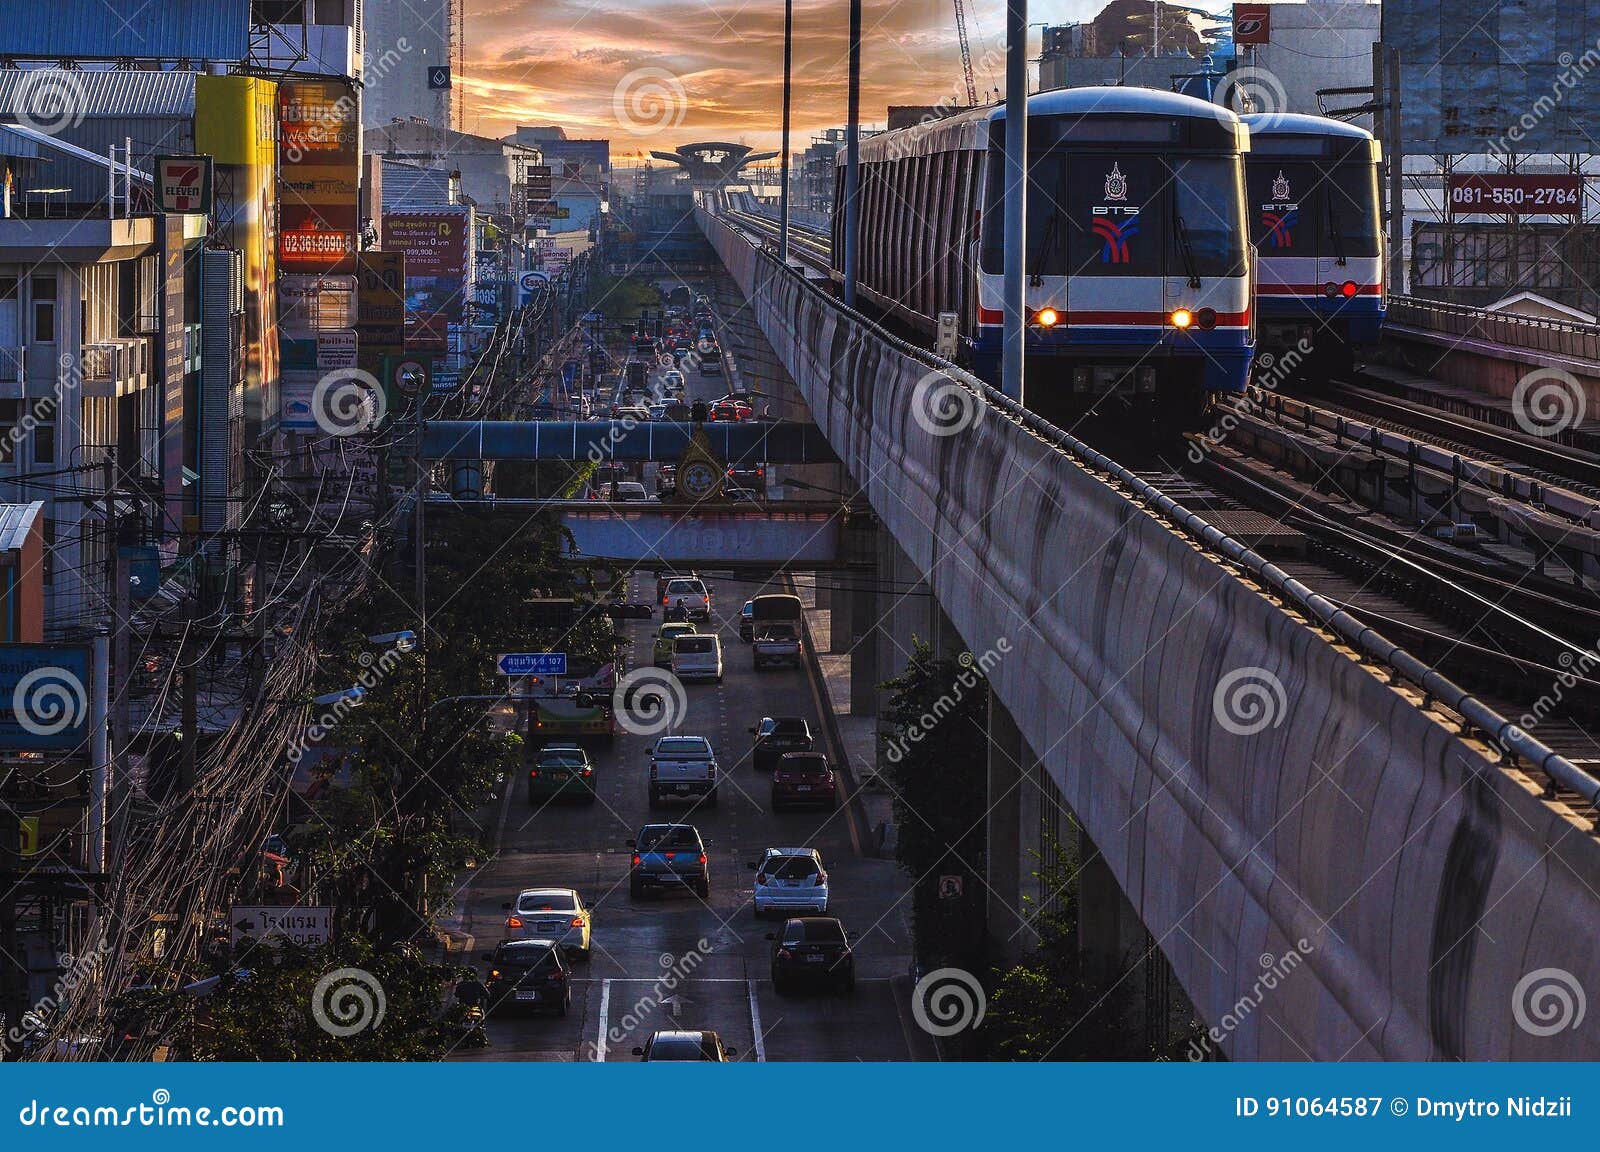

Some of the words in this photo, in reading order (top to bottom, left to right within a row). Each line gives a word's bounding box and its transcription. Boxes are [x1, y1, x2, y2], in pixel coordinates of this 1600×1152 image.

[1453, 187, 1577, 204] 081-550-2784
[1092, 206, 1140, 215] BTS
[1262, 203, 1299, 211] BTS
